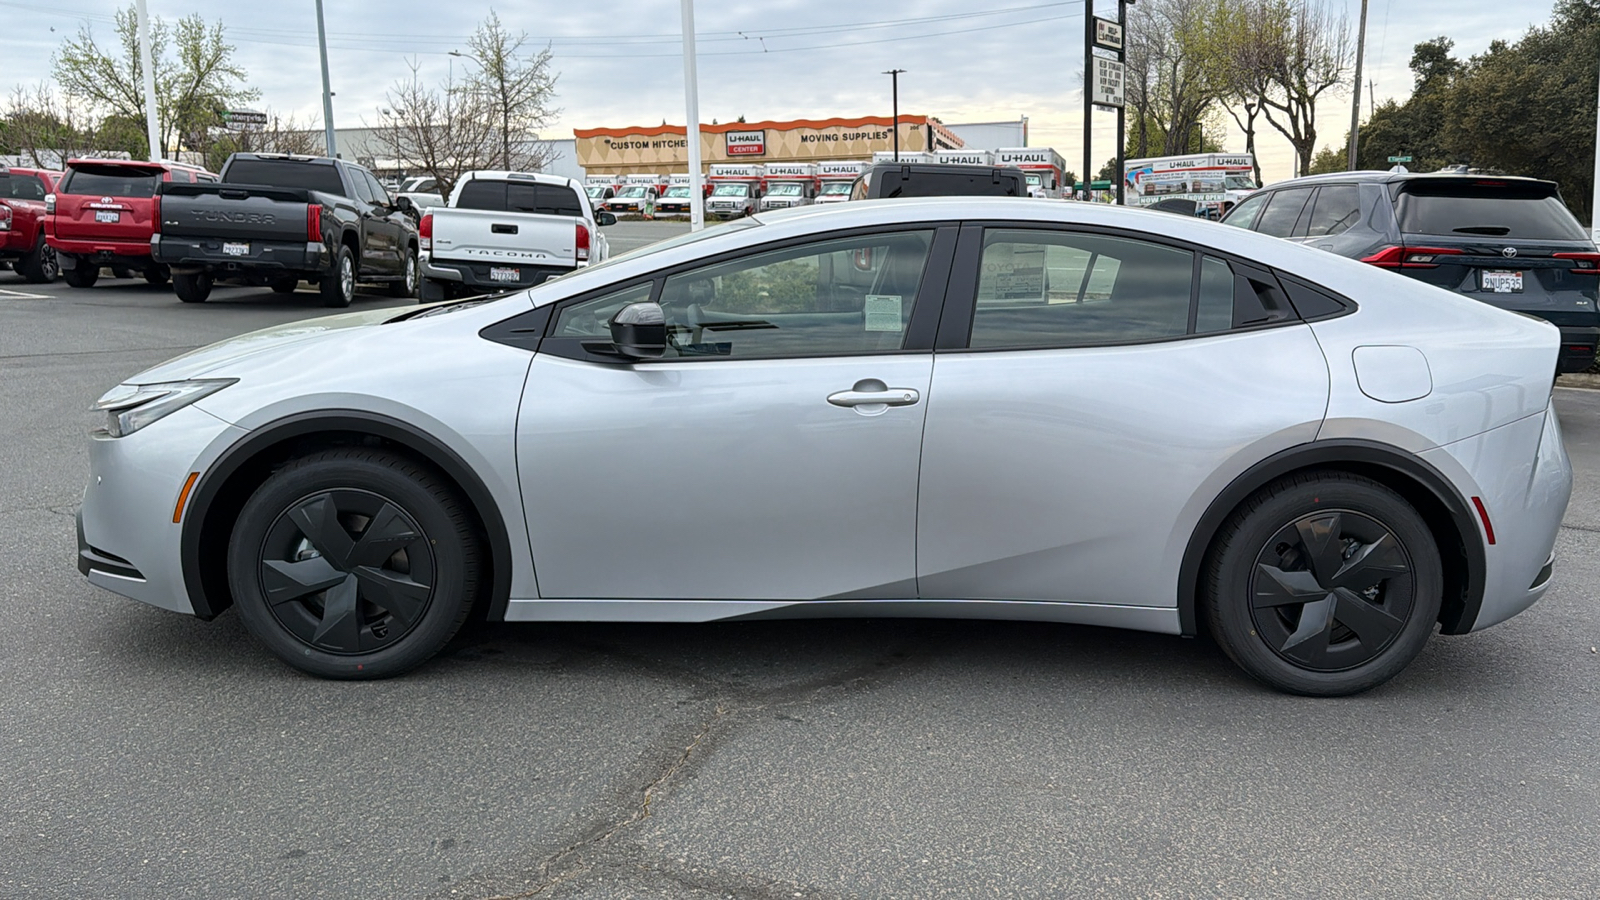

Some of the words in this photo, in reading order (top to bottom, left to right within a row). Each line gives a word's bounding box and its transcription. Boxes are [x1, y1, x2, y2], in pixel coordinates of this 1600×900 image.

[729, 134, 762, 143] U-HAUL
[800, 133, 839, 143] MOVING
[842, 131, 888, 141] SUPPLIES
[610, 141, 650, 150] CUSTOM
[940, 156, 983, 164] U-HAUL
[1001, 154, 1047, 162] U-HAUL
[1169, 160, 1196, 169] U-HAUL
[191, 209, 276, 225] TUNDRA
[464, 249, 547, 259] TACOMA
[1484, 277, 1521, 290] 9NUP535
